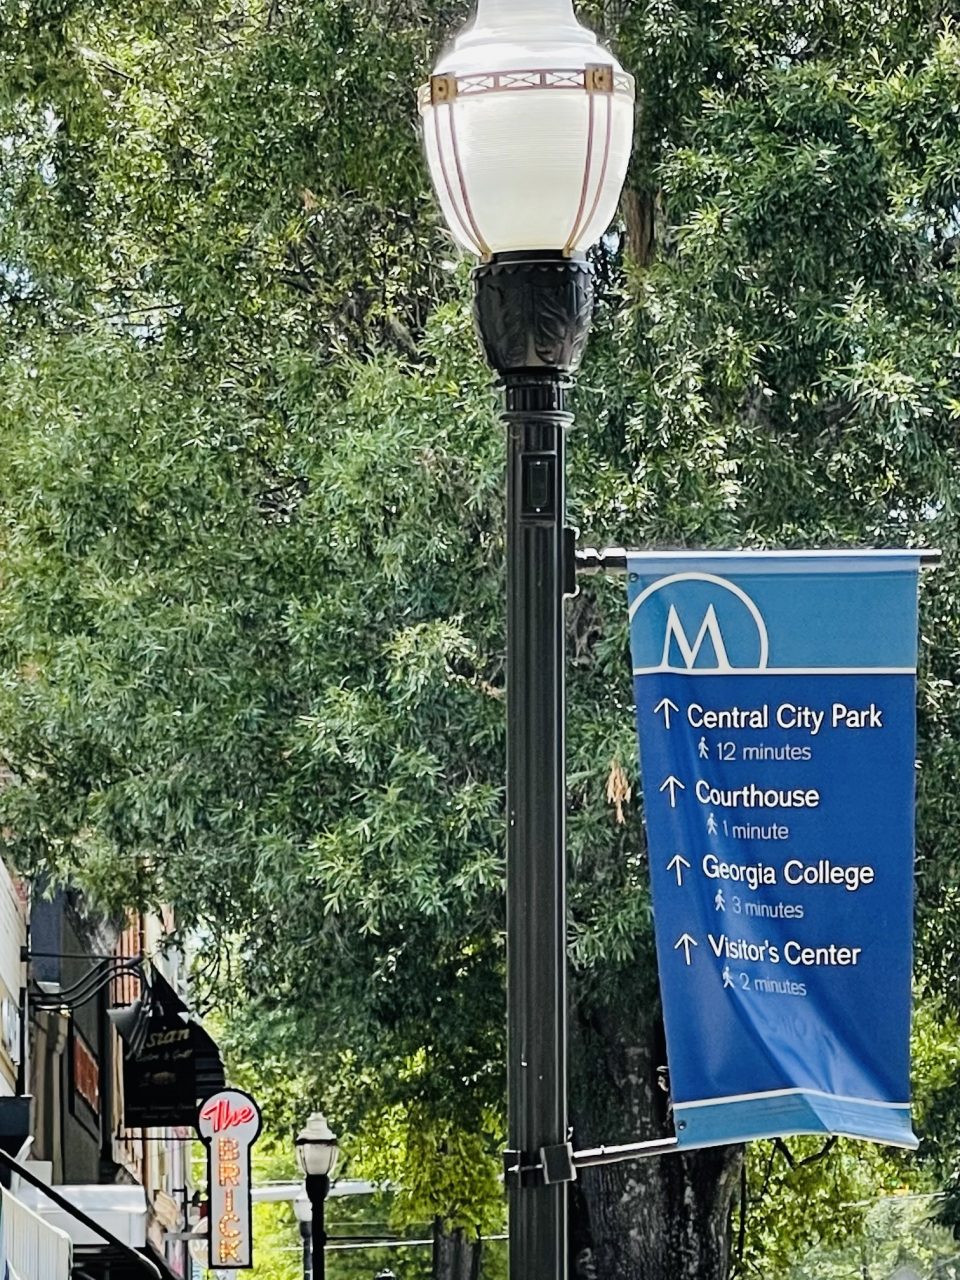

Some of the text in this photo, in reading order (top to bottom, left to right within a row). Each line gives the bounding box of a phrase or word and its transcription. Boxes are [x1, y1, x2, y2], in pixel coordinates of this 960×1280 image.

[687, 703, 883, 735] Central City Park
[716, 742, 812, 761] 12 minutes
[695, 780, 820, 807] Courthouse
[723, 820, 789, 840] 1 minute
[702, 854, 874, 890] Georgia College
[731, 895, 804, 919] 3 minutes
[708, 934, 862, 966] Visitor's Center
[739, 973, 807, 996] 2 minutes
[202, 1100, 254, 1132] The
[218, 1137, 243, 1264] BRICK
